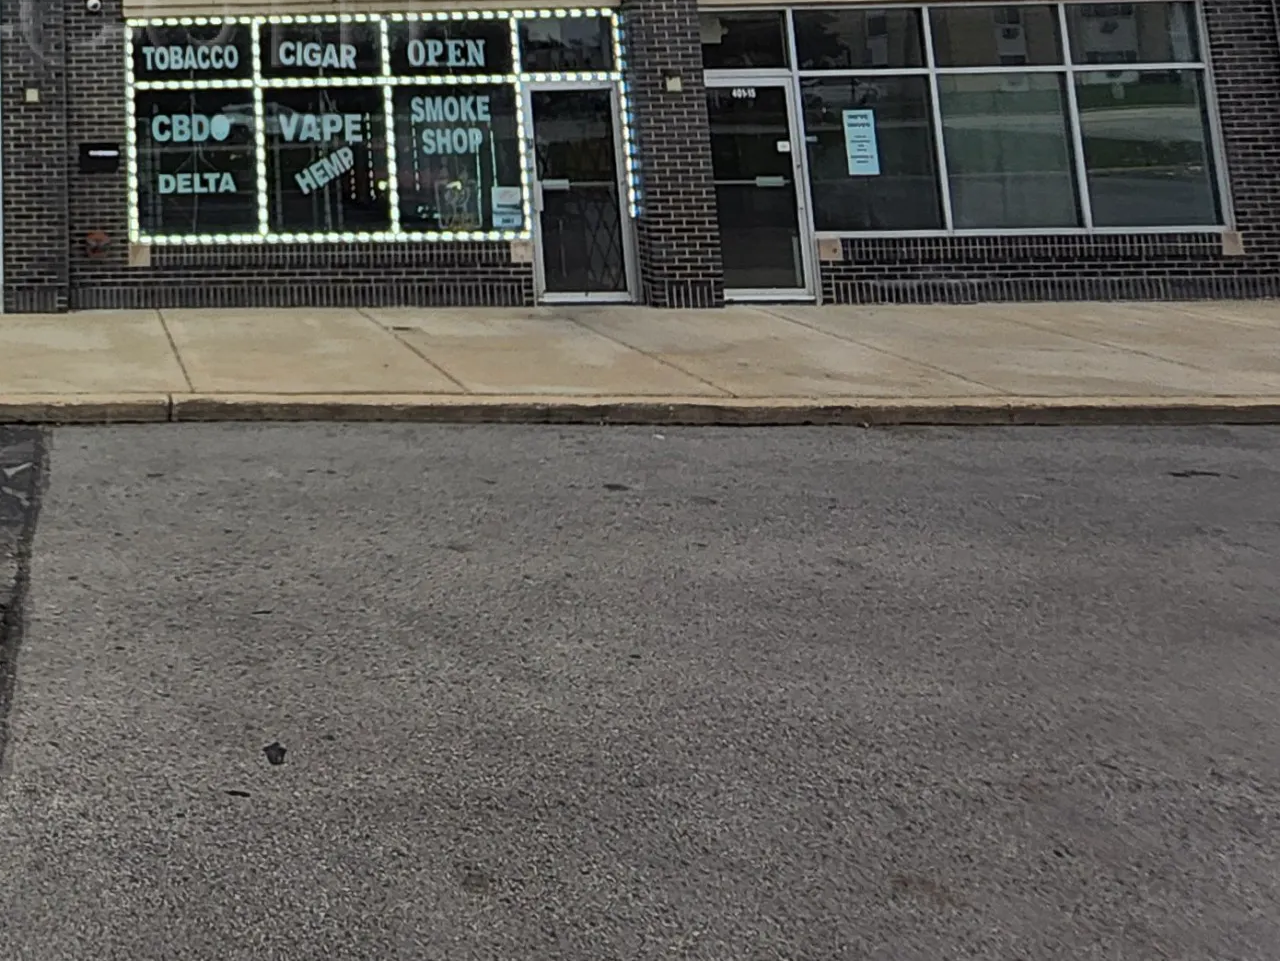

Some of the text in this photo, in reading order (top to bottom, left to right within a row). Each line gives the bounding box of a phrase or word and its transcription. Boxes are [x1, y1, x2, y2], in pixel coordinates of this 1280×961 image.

[141, 44, 240, 71] TOBACCO
[278, 40, 357, 69] CIGAR
[406, 38, 486, 68] OPEN
[410, 94, 492, 123] SMOKE
[278, 113, 363, 143] VAPE
[421, 127, 484, 155] SHOP
[158, 171, 237, 195] DELTA
[293, 145, 355, 196] HEMP
